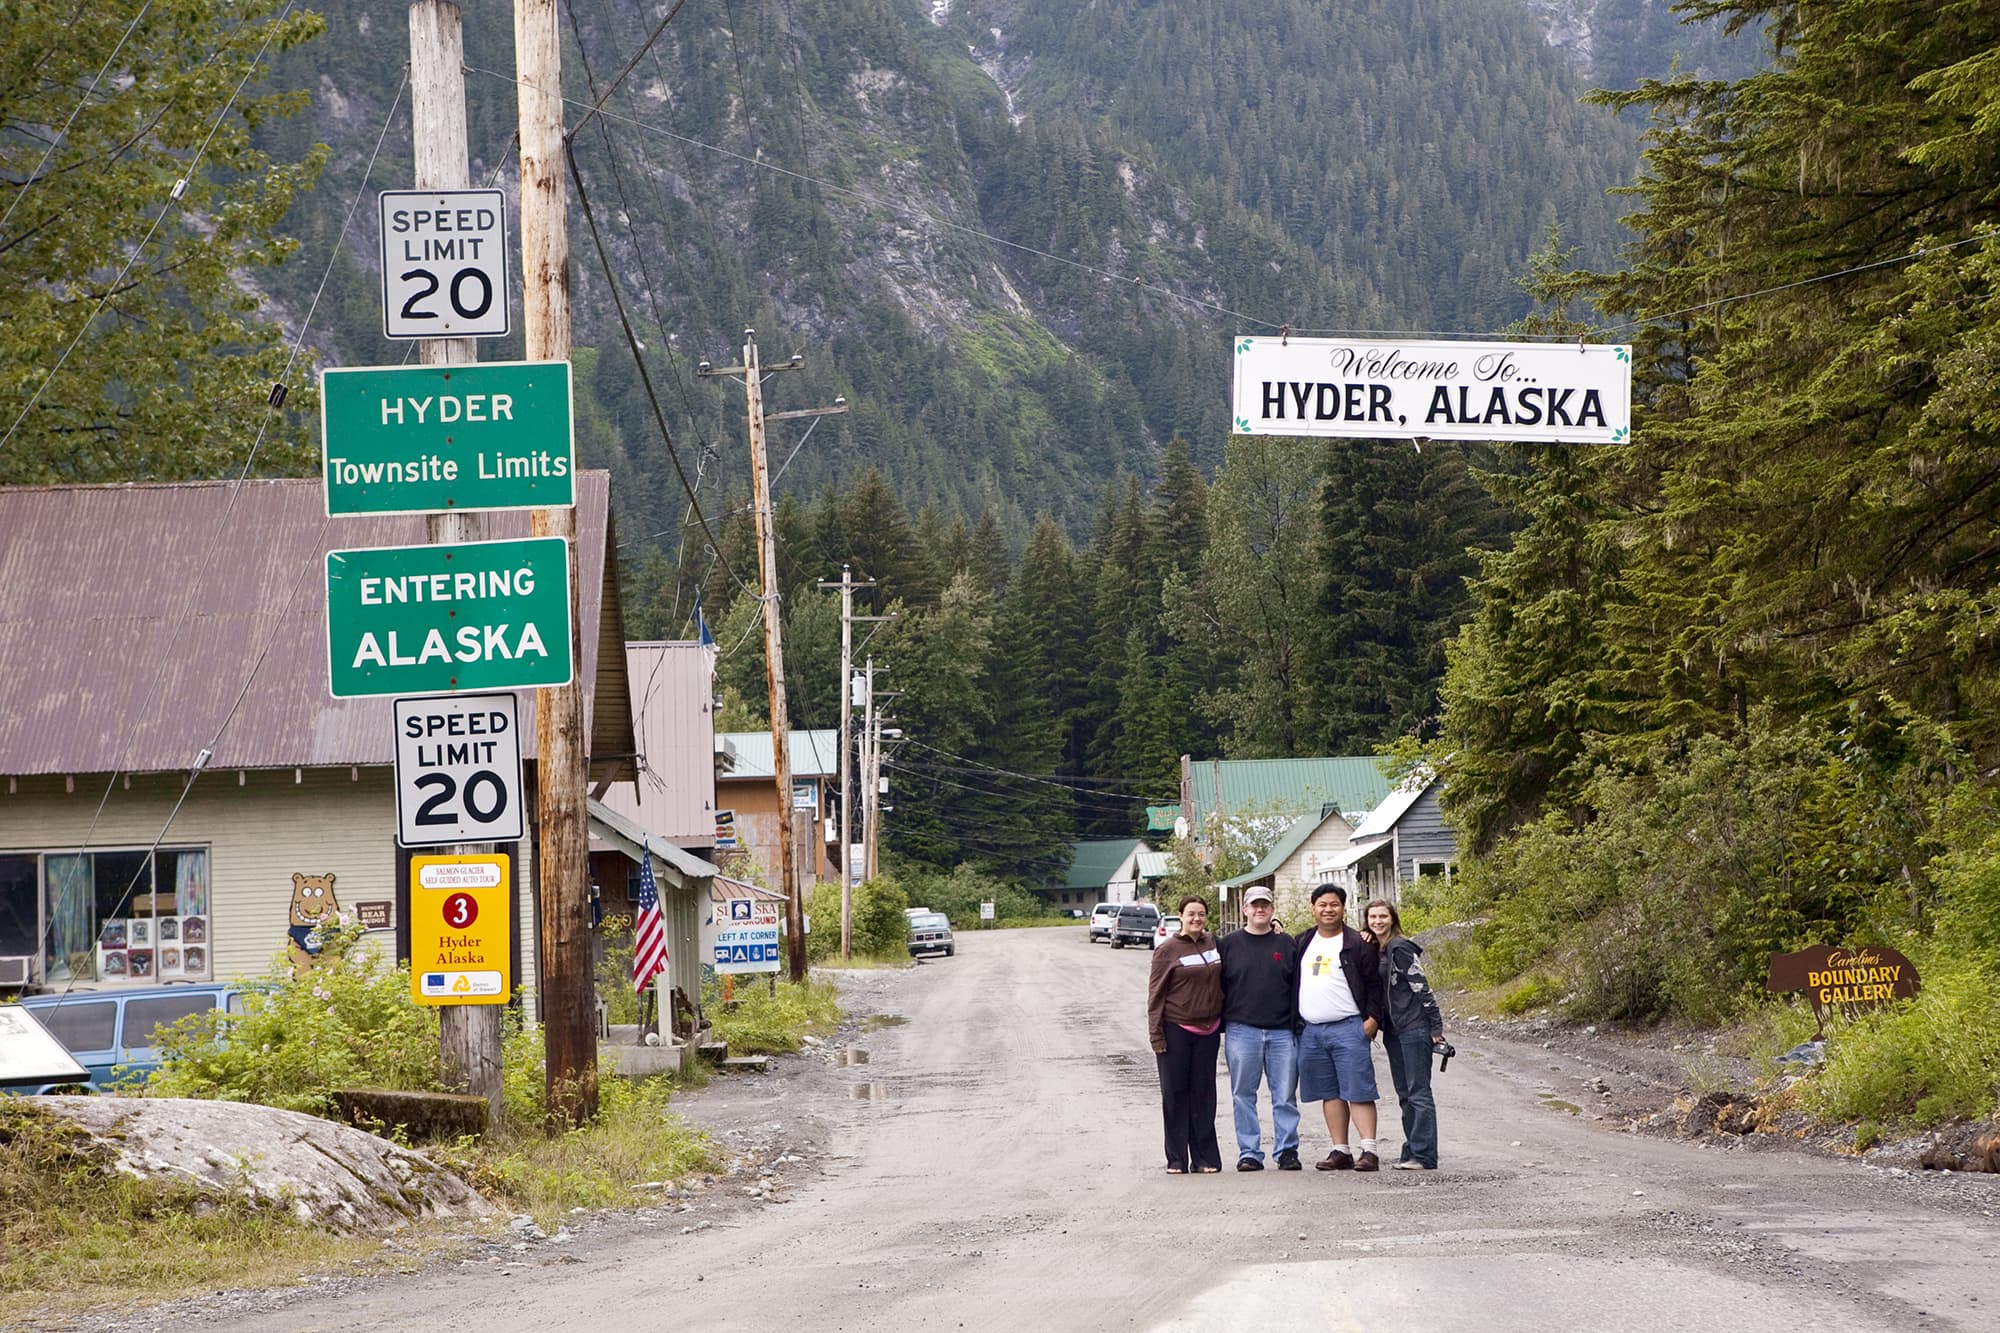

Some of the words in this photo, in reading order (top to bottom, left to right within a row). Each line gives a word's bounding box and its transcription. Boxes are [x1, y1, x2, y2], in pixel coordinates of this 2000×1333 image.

[392, 209, 495, 233] SPEED
[404, 238, 484, 262] LIMIT
[400, 267, 493, 320] 20
[1329, 348, 1460, 381] Welcome
[381, 395, 514, 425] HYDER
[1260, 381, 1408, 427] HYDER,
[1425, 385, 1609, 428] ALASKA
[329, 455, 458, 485] Townsite
[478, 451, 568, 480] Limits
[360, 568, 536, 605] ENTERING
[352, 622, 549, 668] ALASKA
[405, 711, 509, 738] SPEED
[417, 741, 498, 767] LIMIT
[413, 770, 508, 826] 20
[435, 867, 459, 876] SALMON
[460, 866, 485, 875] GLACIER
[439, 876, 461, 884] GUIDED
[462, 875, 479, 884] AUTO
[479, 875, 496, 883] TOUR
[453, 898, 468, 924] 3
[439, 935, 482, 951] Hyder
[718, 933, 736, 942] LEFT
[739, 932, 749, 941] AT
[750, 931, 777, 940] CORNER
[436, 952, 485, 965] Alaska
[1808, 965, 1902, 988] BOUNDARY
[1819, 983, 1895, 1004] GALLERY
